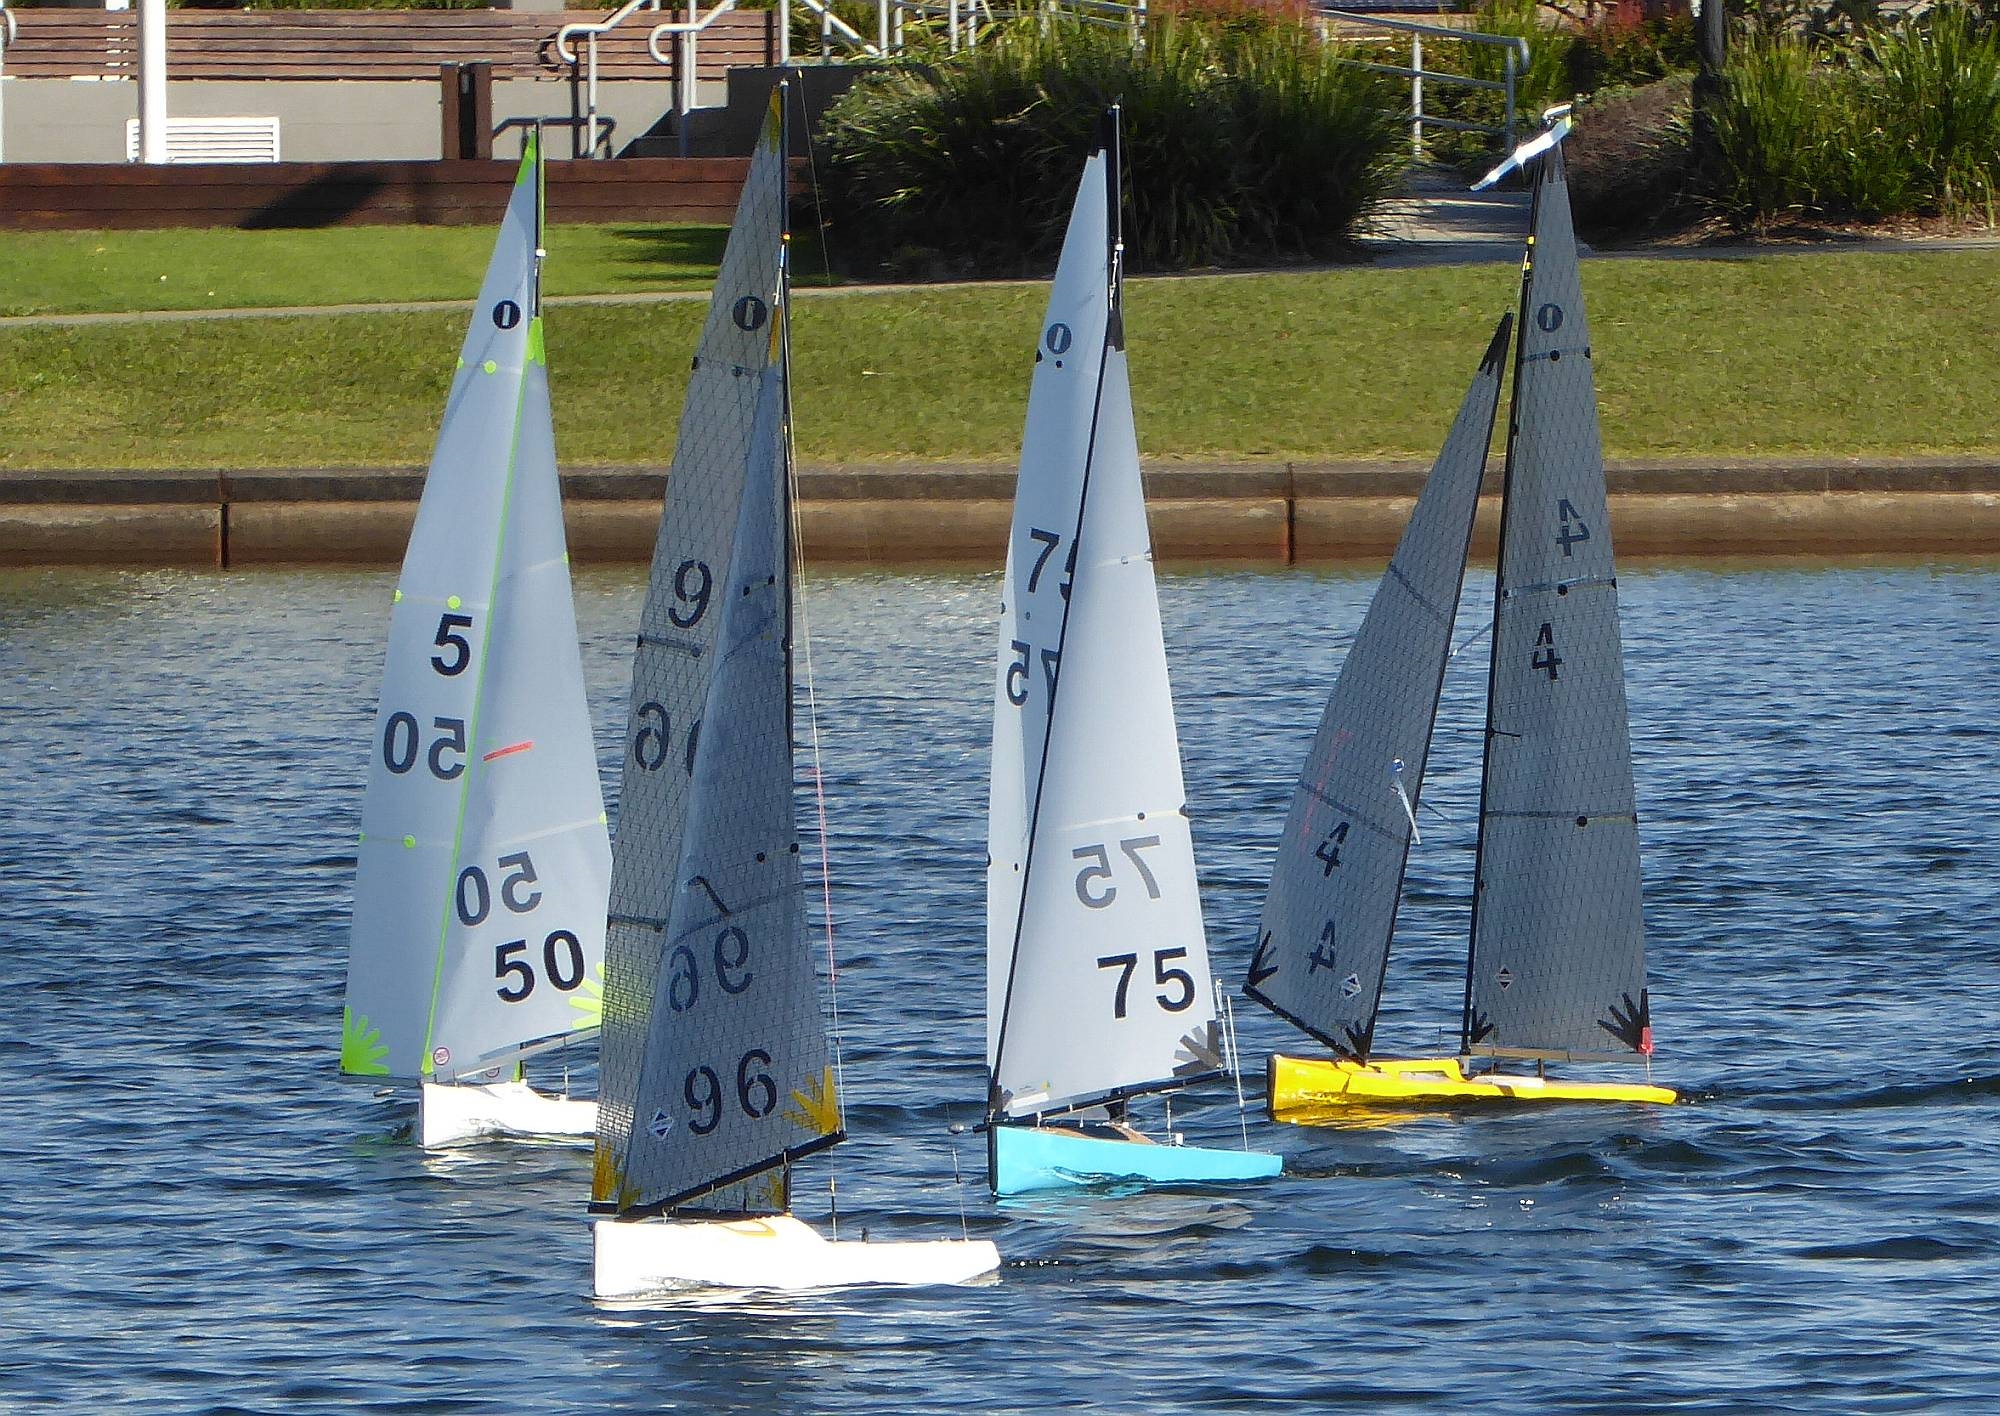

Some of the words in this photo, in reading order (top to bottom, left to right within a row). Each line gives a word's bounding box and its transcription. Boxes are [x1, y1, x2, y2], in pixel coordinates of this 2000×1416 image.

[1532, 622, 1563, 681] 4
[1316, 821, 1350, 878] 4
[495, 929, 585, 1003] 50
[1097, 946, 1196, 1019] 75
[684, 1048, 777, 1136] 96
